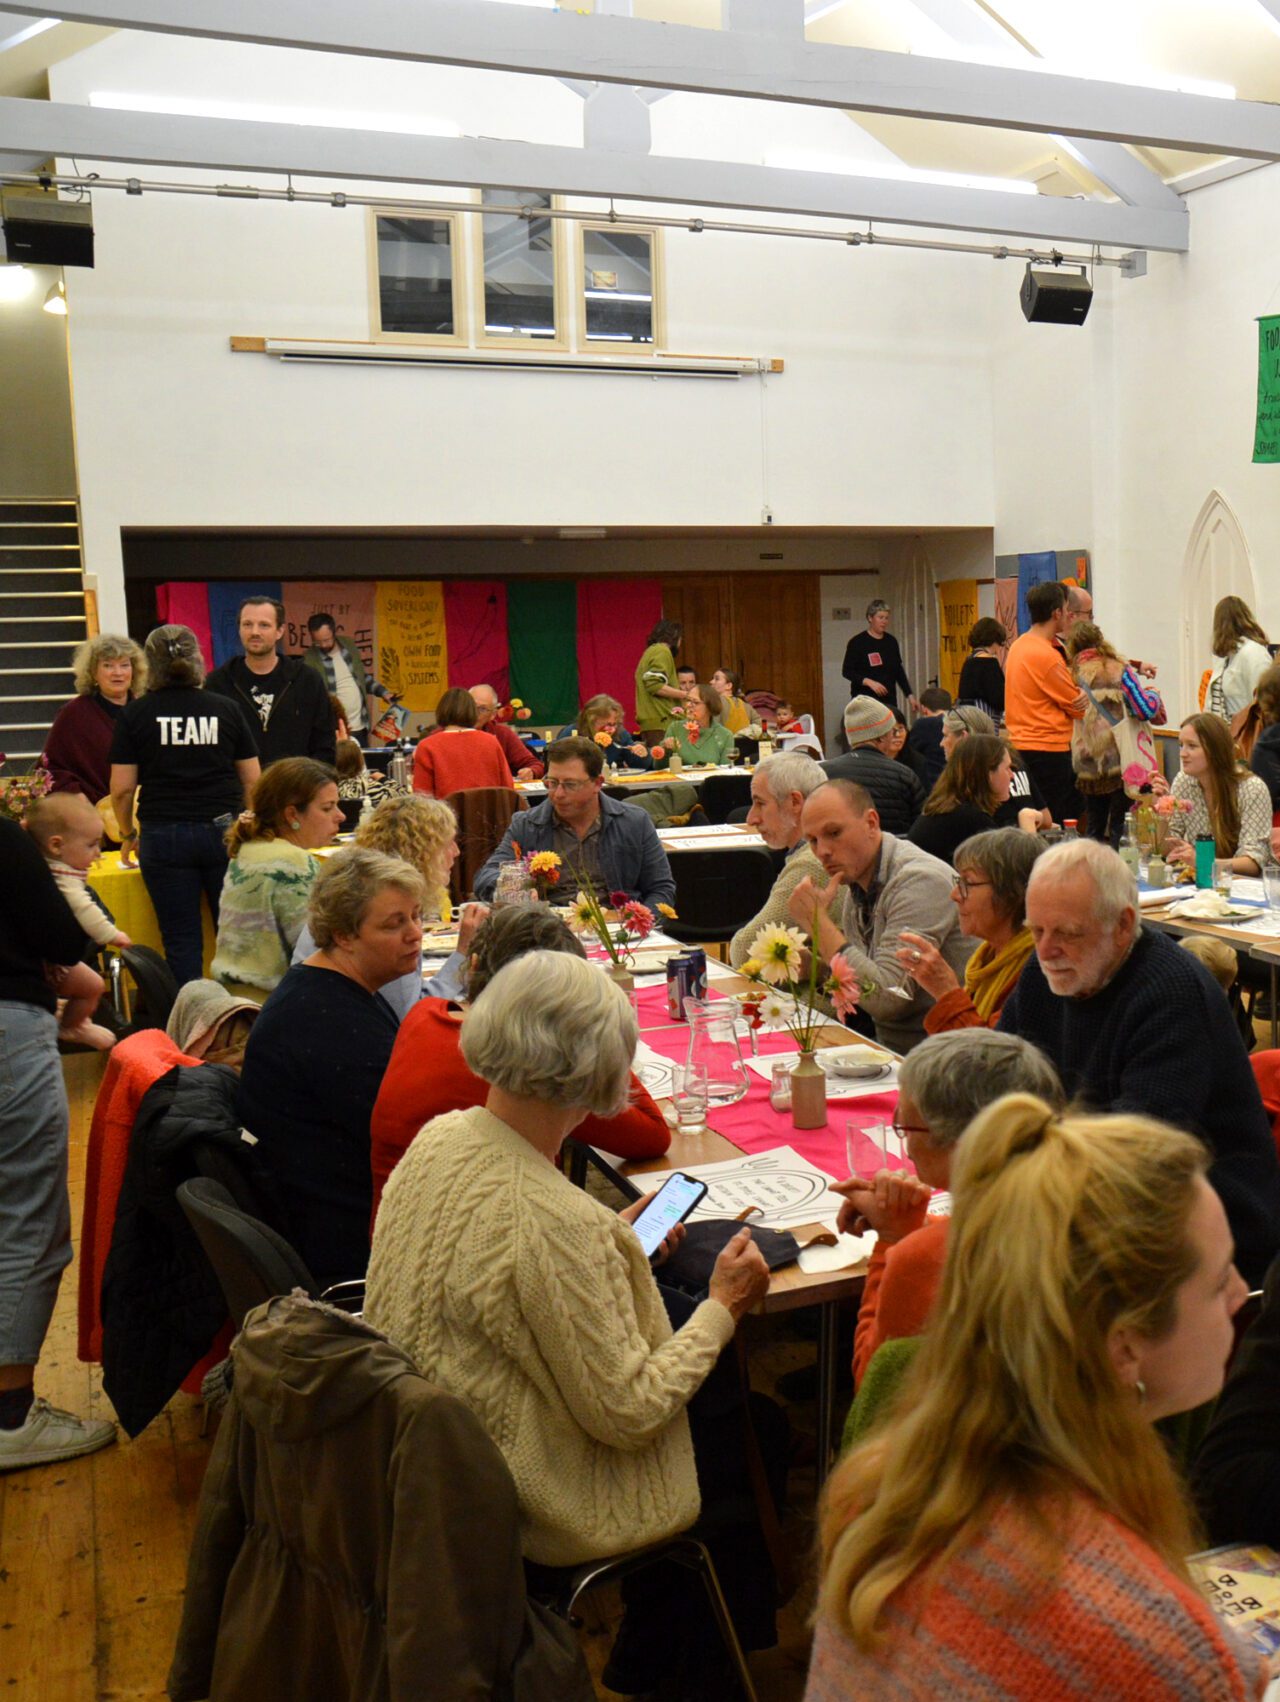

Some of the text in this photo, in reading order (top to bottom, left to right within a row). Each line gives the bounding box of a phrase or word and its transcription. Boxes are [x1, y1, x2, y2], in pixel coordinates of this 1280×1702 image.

[398, 583, 425, 597] FOOD
[943, 603, 975, 627] TOILETS
[408, 671, 440, 685] SYSTEMS
[156, 715, 219, 746] TEAM
